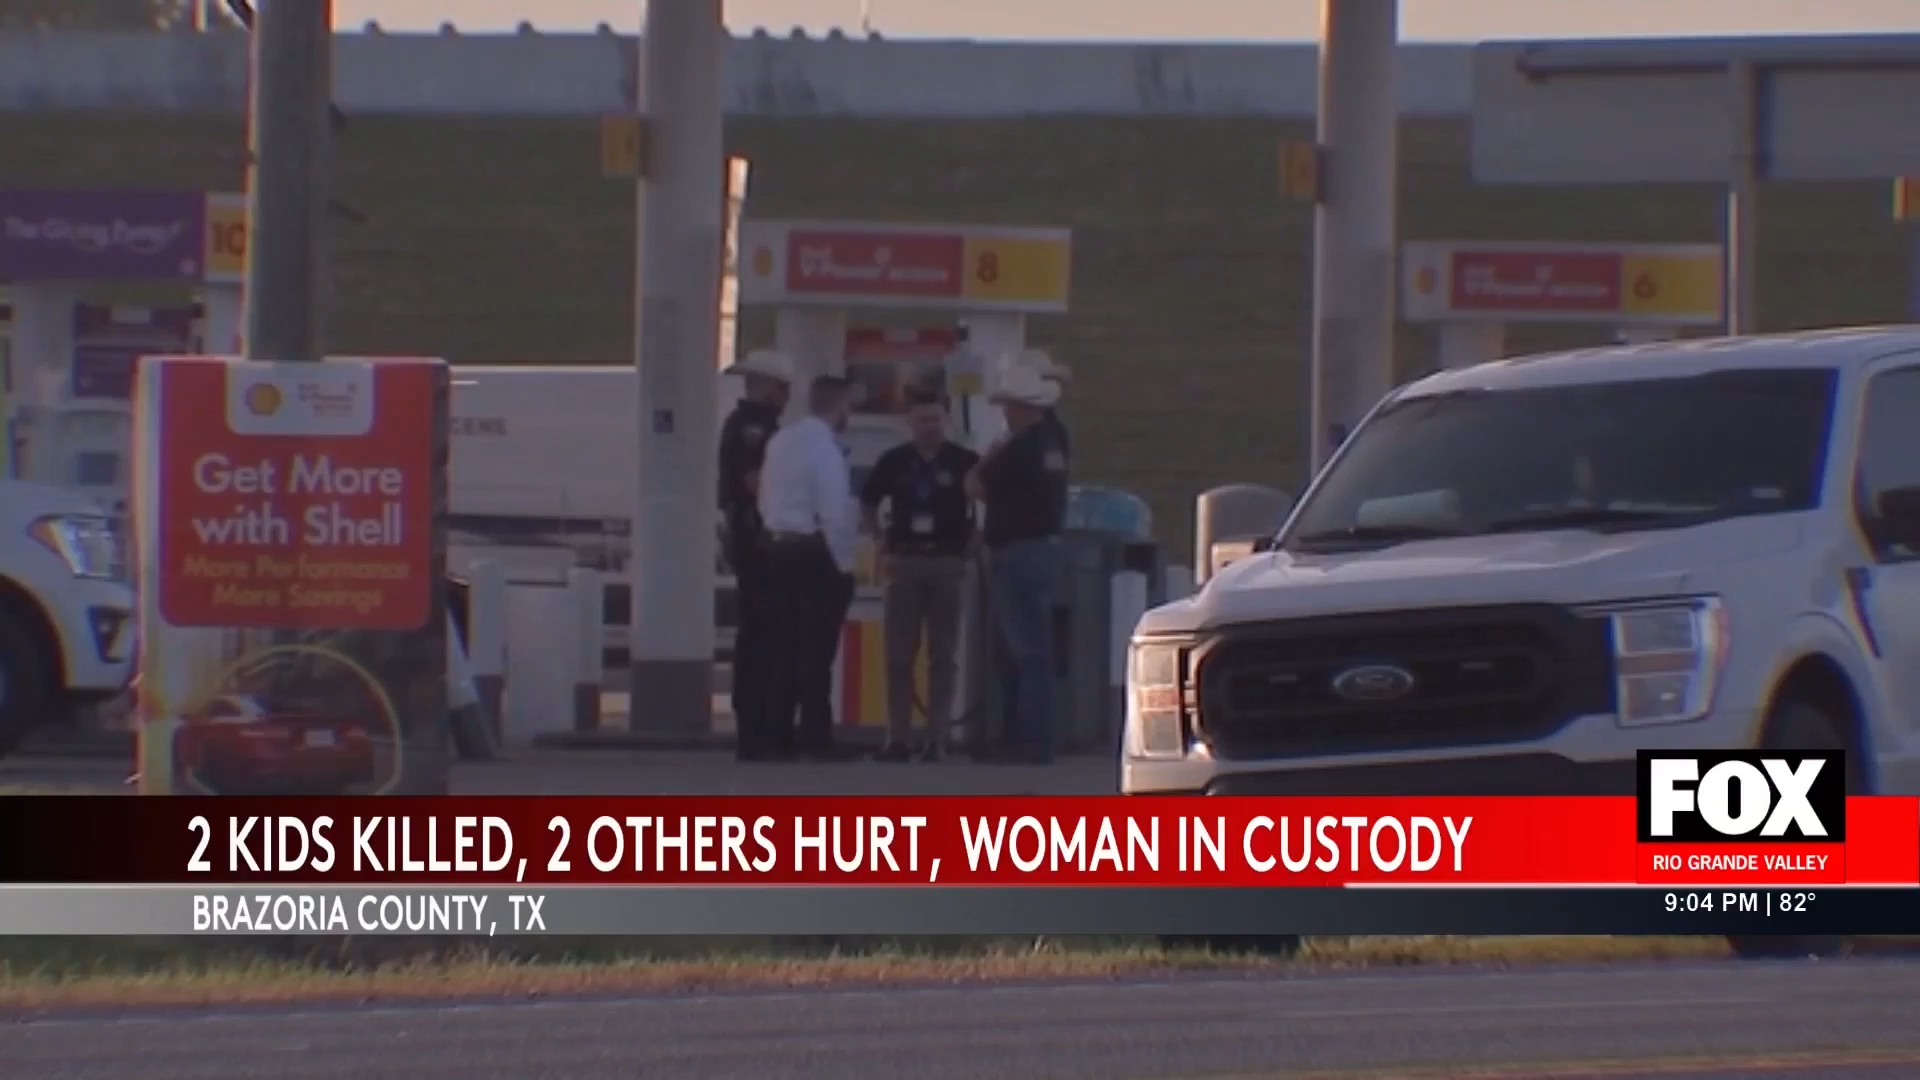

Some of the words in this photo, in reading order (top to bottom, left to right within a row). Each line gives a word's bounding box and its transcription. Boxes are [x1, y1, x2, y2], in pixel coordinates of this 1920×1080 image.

[976, 251, 998, 283] 8
[1633, 271, 1657, 299] 6
[193, 452, 276, 494] Get
[288, 454, 403, 495] More
[191, 502, 290, 546] with
[302, 501, 402, 546] Shell
[182, 555, 249, 578] More
[213, 583, 281, 606] More
